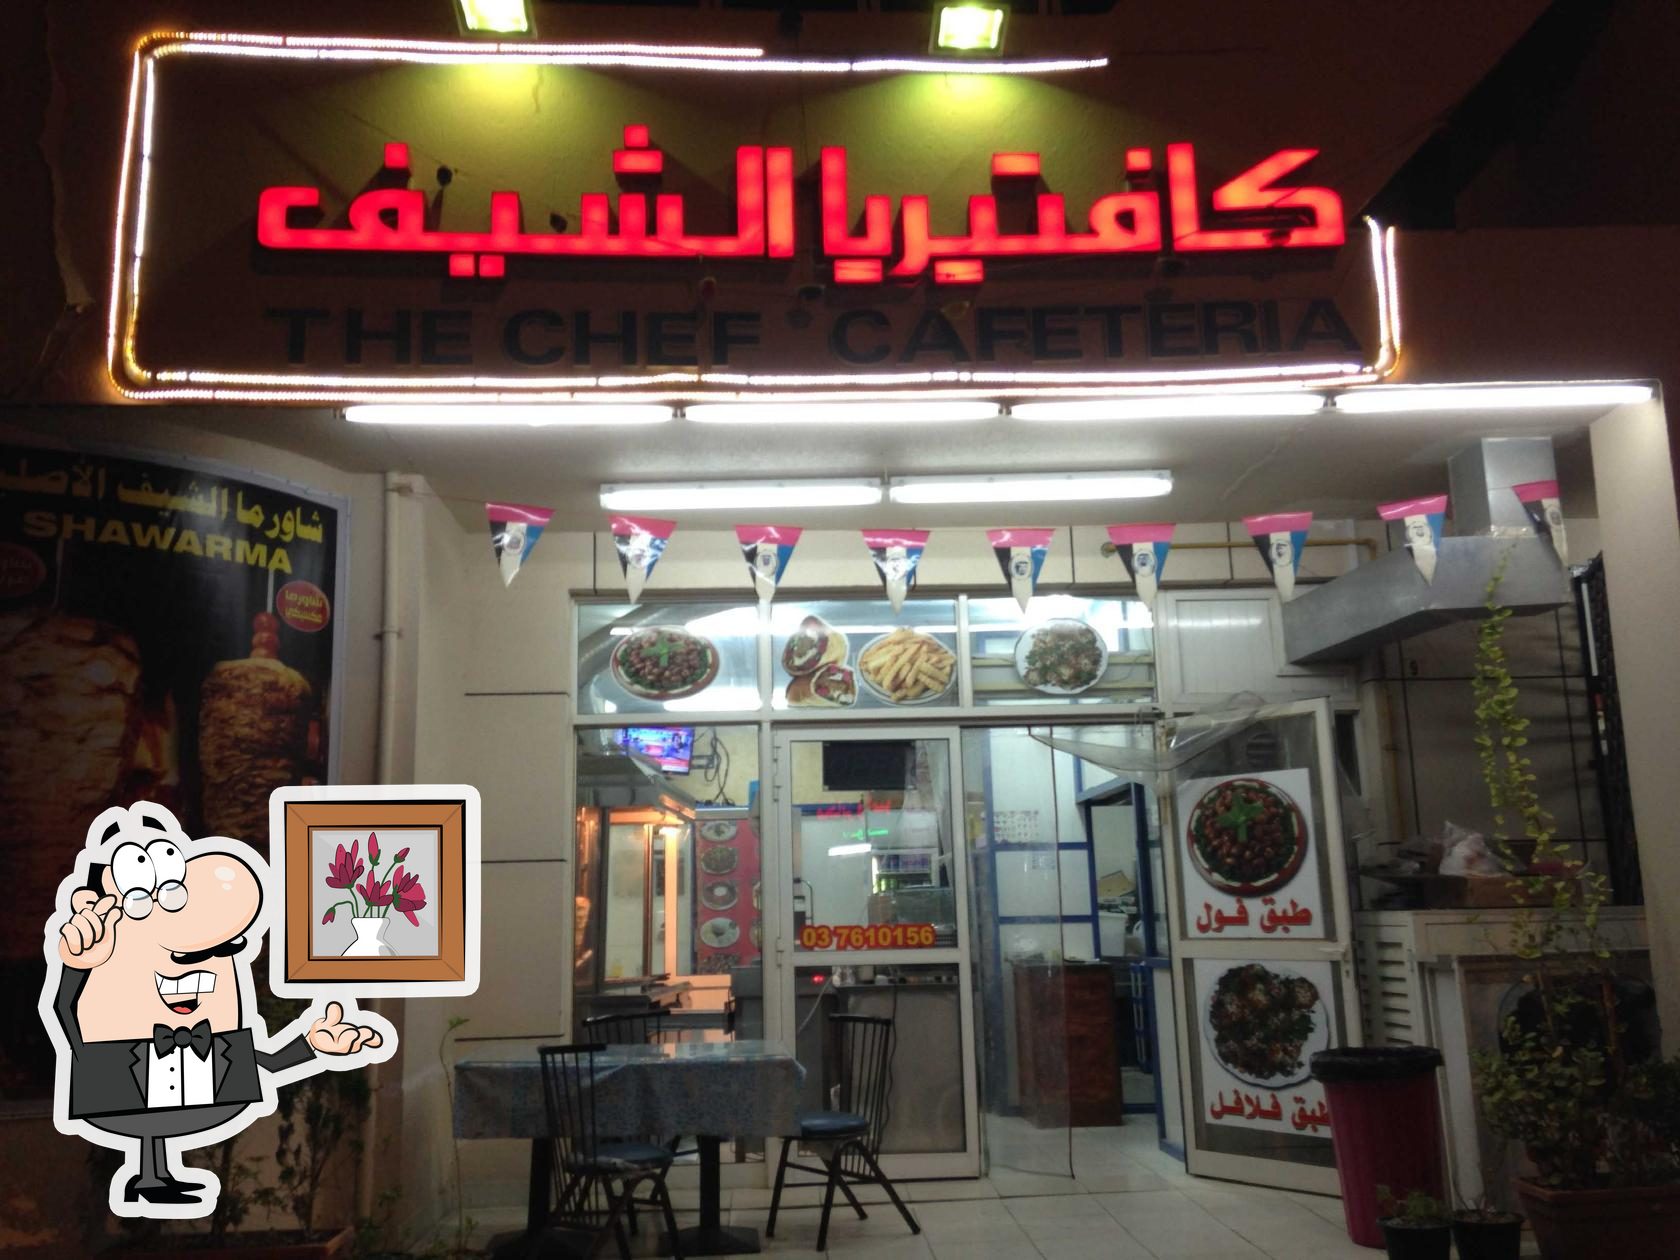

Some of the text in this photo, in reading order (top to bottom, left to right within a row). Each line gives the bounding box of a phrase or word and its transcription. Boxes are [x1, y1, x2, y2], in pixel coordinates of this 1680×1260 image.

[257, 124, 1346, 284] كافتيريا الشيف
[266, 299, 1363, 367] THE CHEF CAFETERIA
[116, 472, 229, 521] الشيف
[236, 490, 324, 544] شاورما
[23, 510, 293, 575] SHAWARMA
[801, 925, 935, 949] 03 7610156
[1196, 895, 1313, 934] طبق فول
[1210, 1088, 1284, 1121] فلافل
